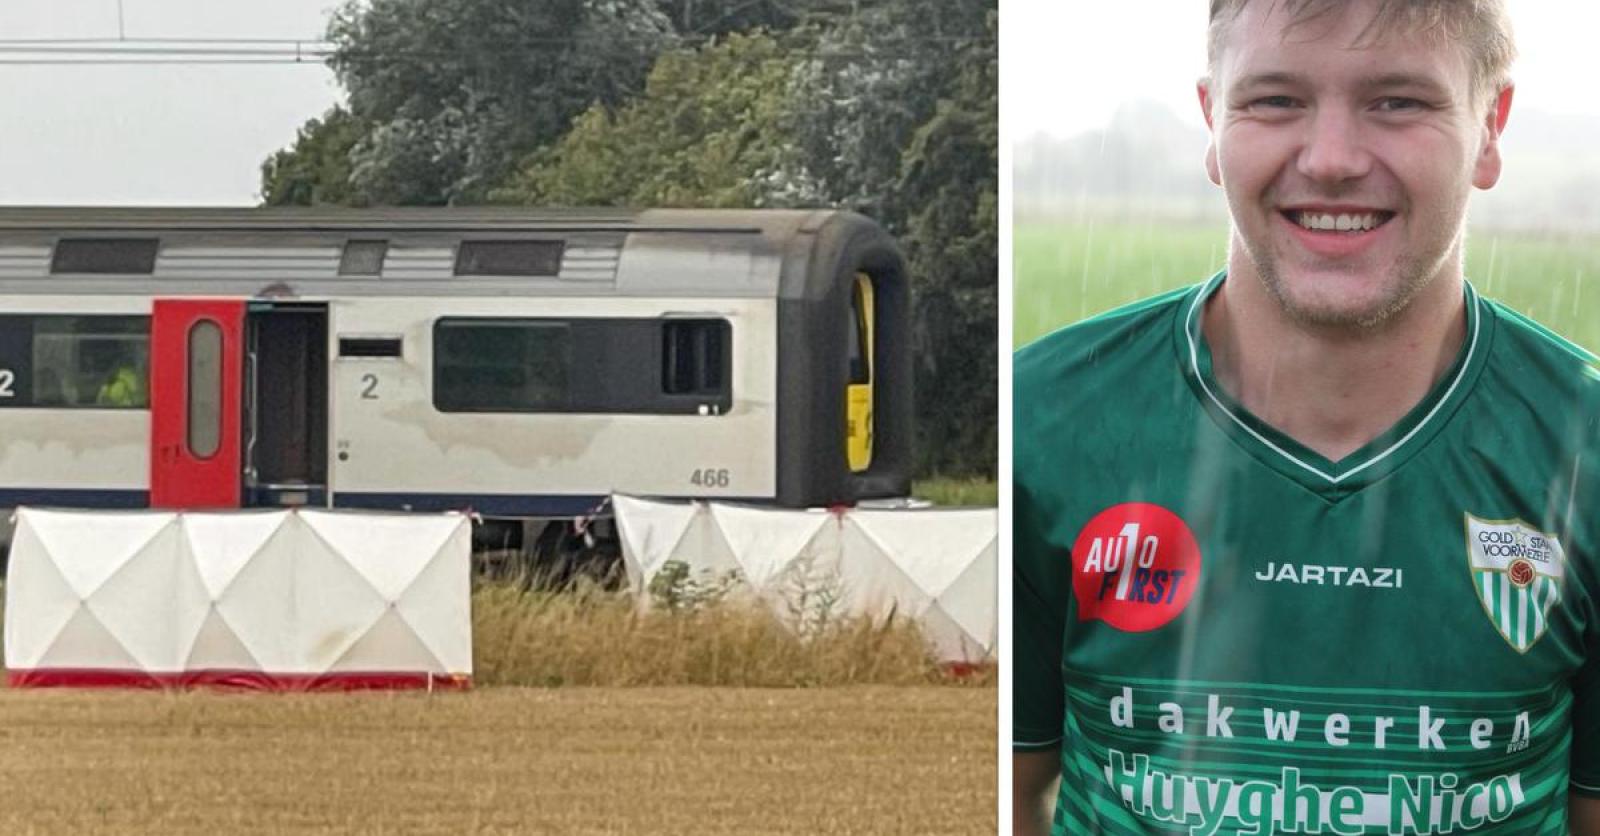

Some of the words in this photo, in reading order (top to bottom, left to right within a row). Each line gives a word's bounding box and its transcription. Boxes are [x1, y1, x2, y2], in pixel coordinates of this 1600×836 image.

[0, 369, 15, 397] 2
[361, 373, 379, 399] 2
[690, 469, 729, 487] 466
[1478, 531, 1514, 544] GOLD
[1255, 562, 1403, 588] JARTAZI
[1108, 749, 1366, 836] Huyghe
[1387, 773, 1517, 836] Nico
